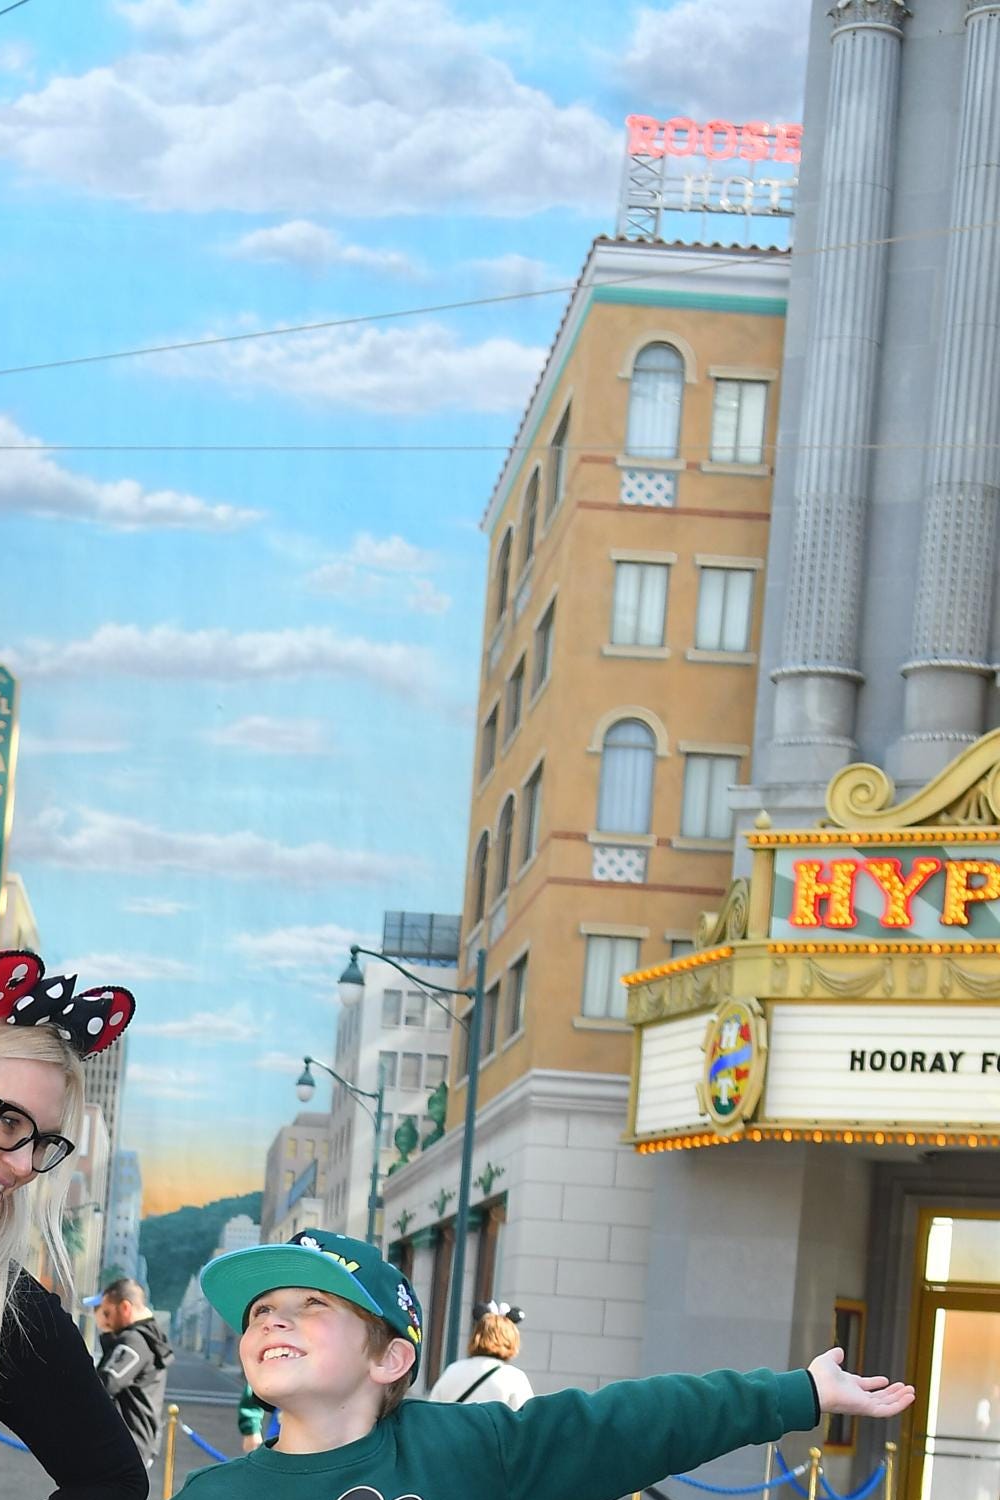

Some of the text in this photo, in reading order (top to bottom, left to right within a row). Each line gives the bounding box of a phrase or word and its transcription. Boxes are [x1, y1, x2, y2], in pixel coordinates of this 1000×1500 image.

[626, 114, 803, 163] ROOSE
[789, 857, 1000, 929] HYP
[850, 1050, 1000, 1074] HOORAY F
